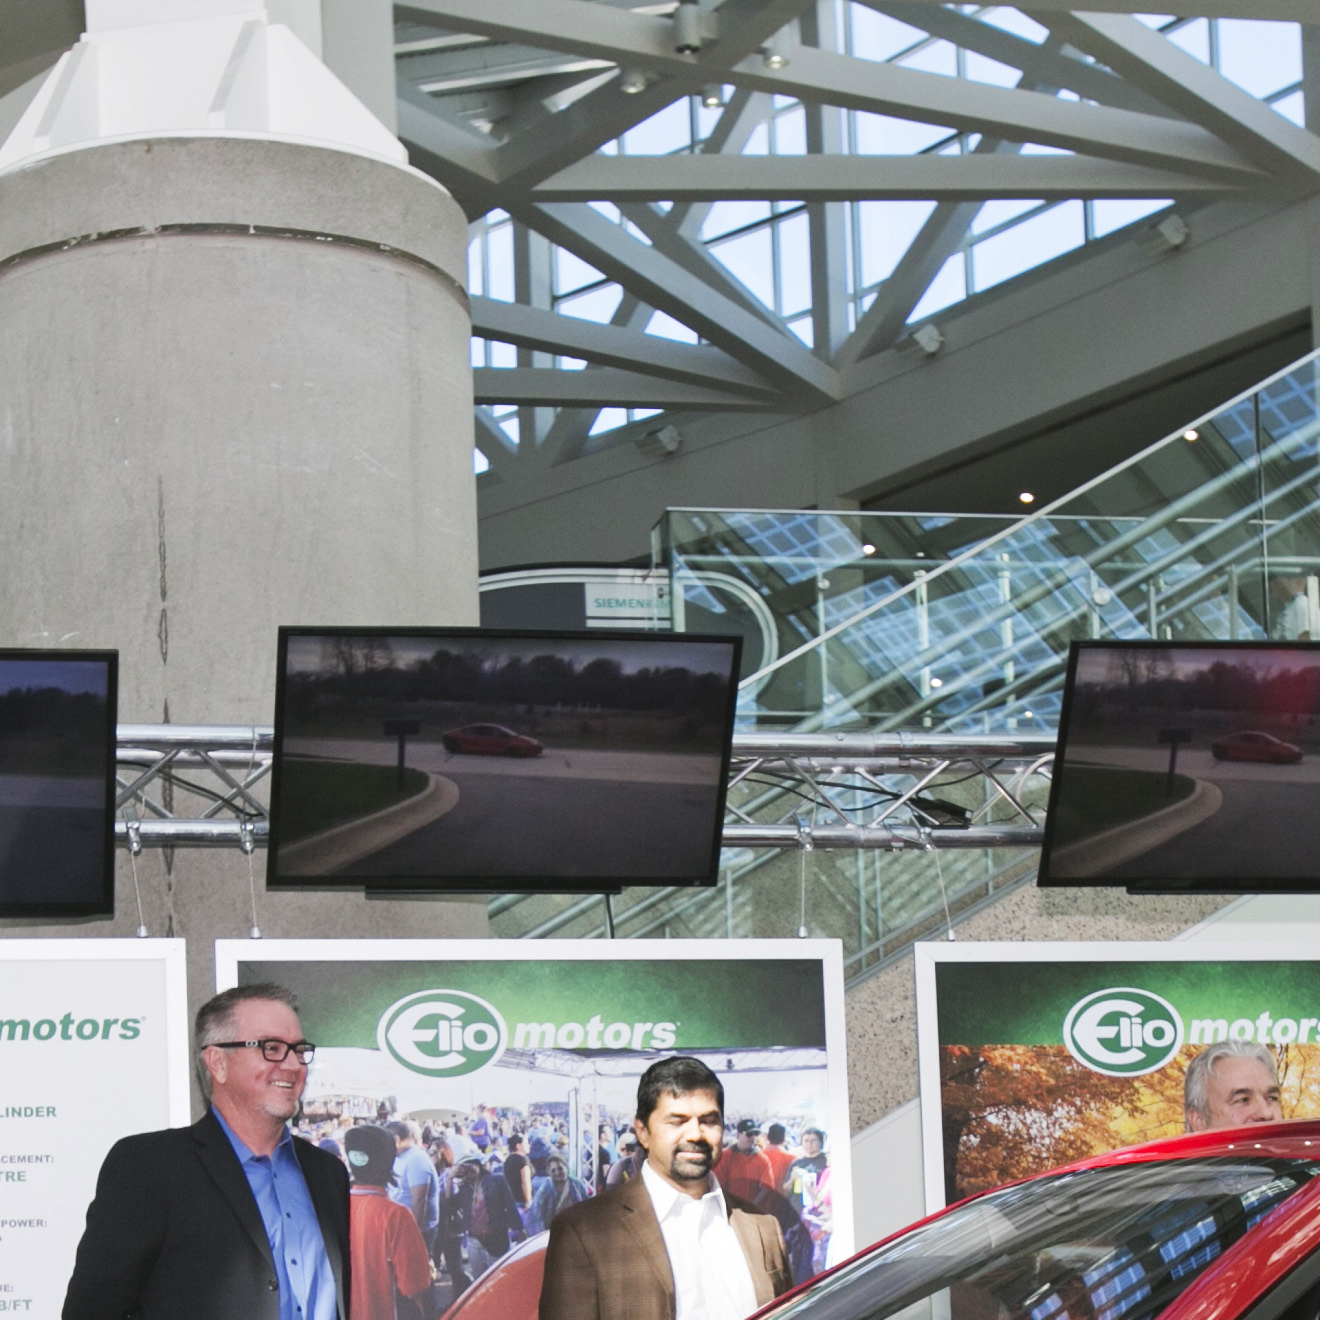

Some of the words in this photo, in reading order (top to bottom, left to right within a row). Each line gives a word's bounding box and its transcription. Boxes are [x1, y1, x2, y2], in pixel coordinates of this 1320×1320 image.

[387, 1001, 499, 1069] Elio
[514, 1014, 677, 1050] motors
[1072, 999, 1176, 1065] Elio
